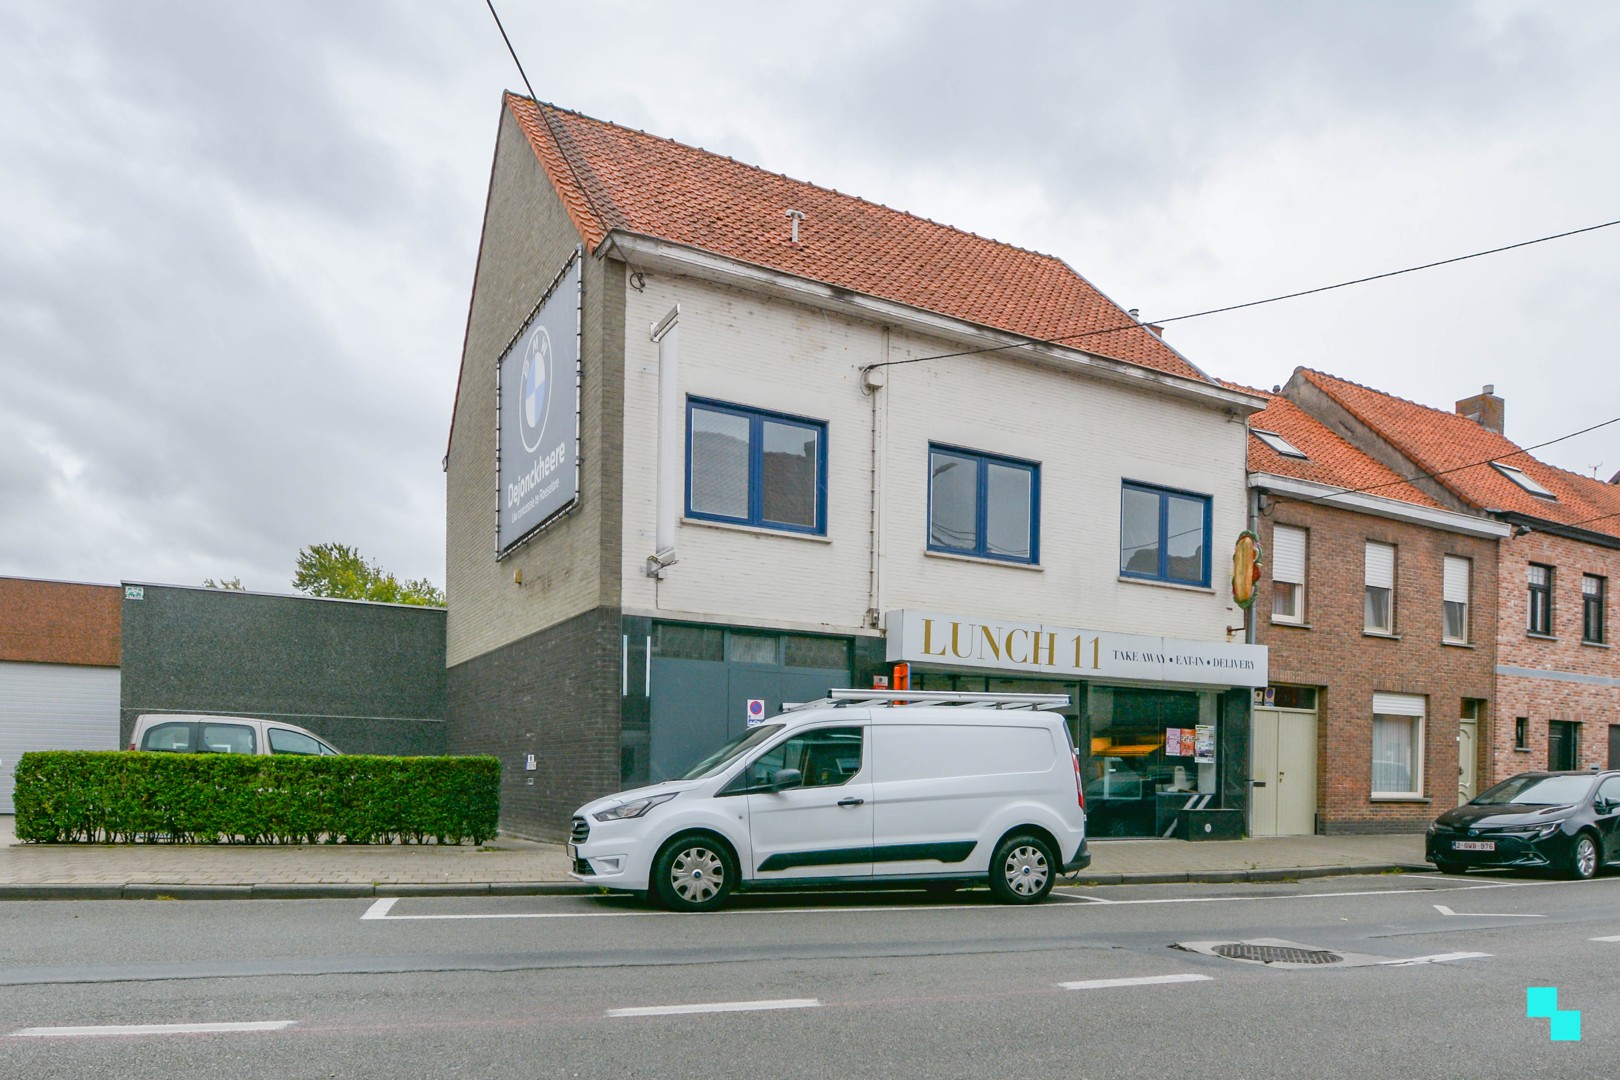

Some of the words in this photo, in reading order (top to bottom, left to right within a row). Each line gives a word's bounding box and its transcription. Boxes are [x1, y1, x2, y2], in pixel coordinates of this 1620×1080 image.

[522, 334, 548, 379] BMW
[508, 441, 566, 509] Dejonckheere
[920, 618, 1058, 667] LUNCH
[1071, 634, 1102, 670] 11
[1112, 649, 1139, 662] TAKE
[1141, 652, 1166, 664] AWAY
[1175, 655, 1205, 667] EAT-IN
[1213, 657, 1256, 671] DELIVERY
